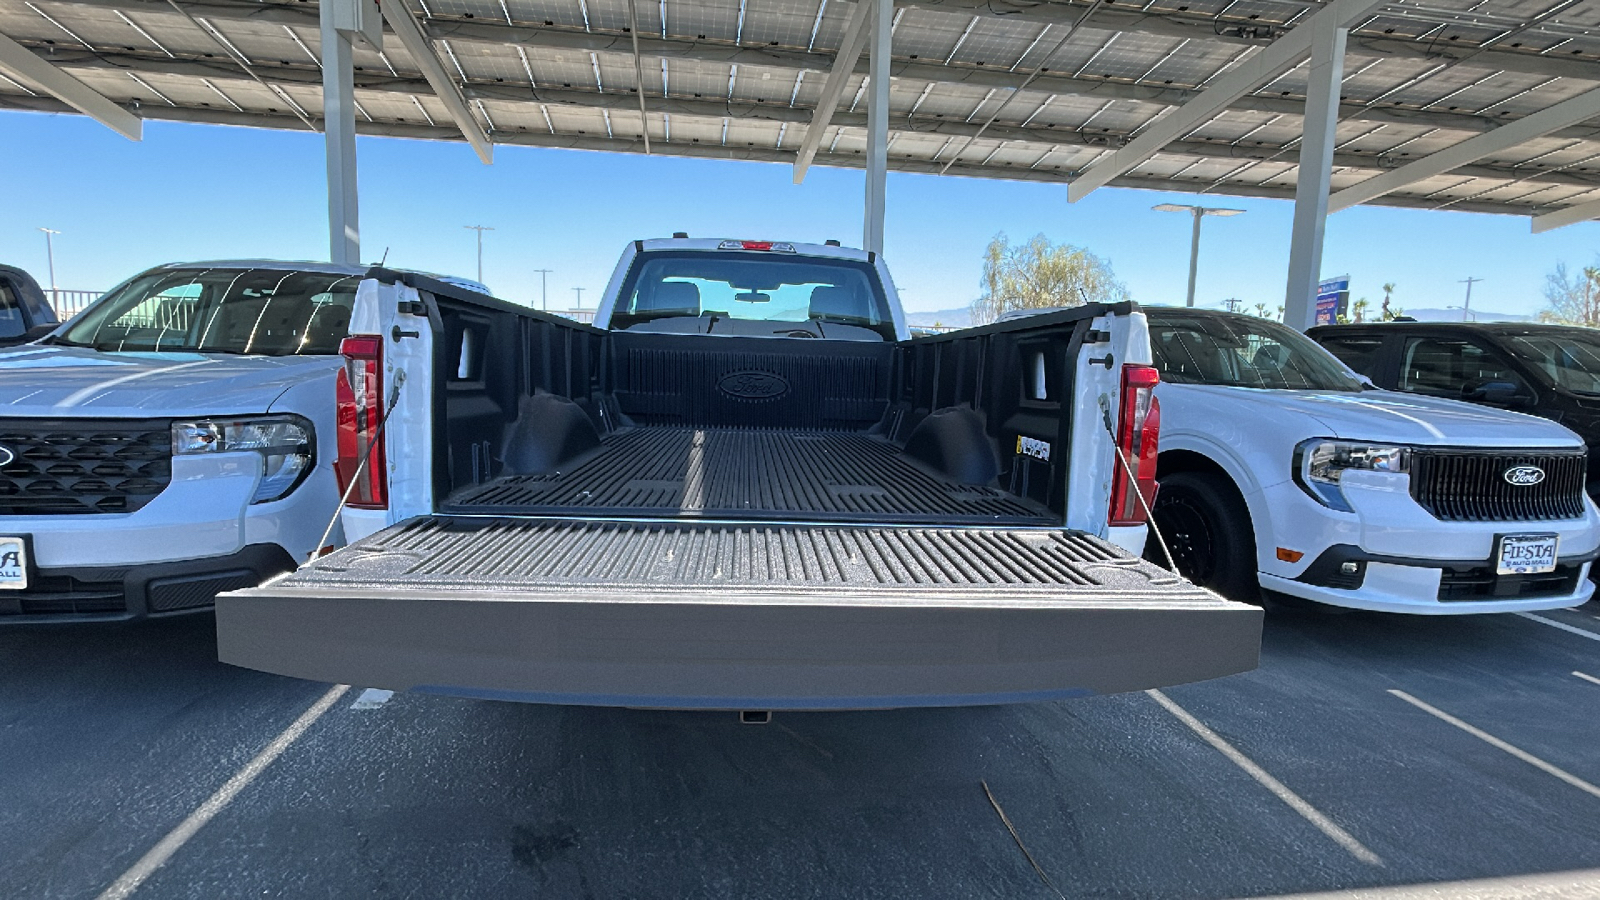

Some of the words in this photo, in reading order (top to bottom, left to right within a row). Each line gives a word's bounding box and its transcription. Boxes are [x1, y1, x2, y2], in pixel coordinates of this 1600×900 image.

[733, 376, 775, 394] Ford
[1512, 469, 1539, 482] Ford
[1502, 543, 1554, 562] FIESTA
